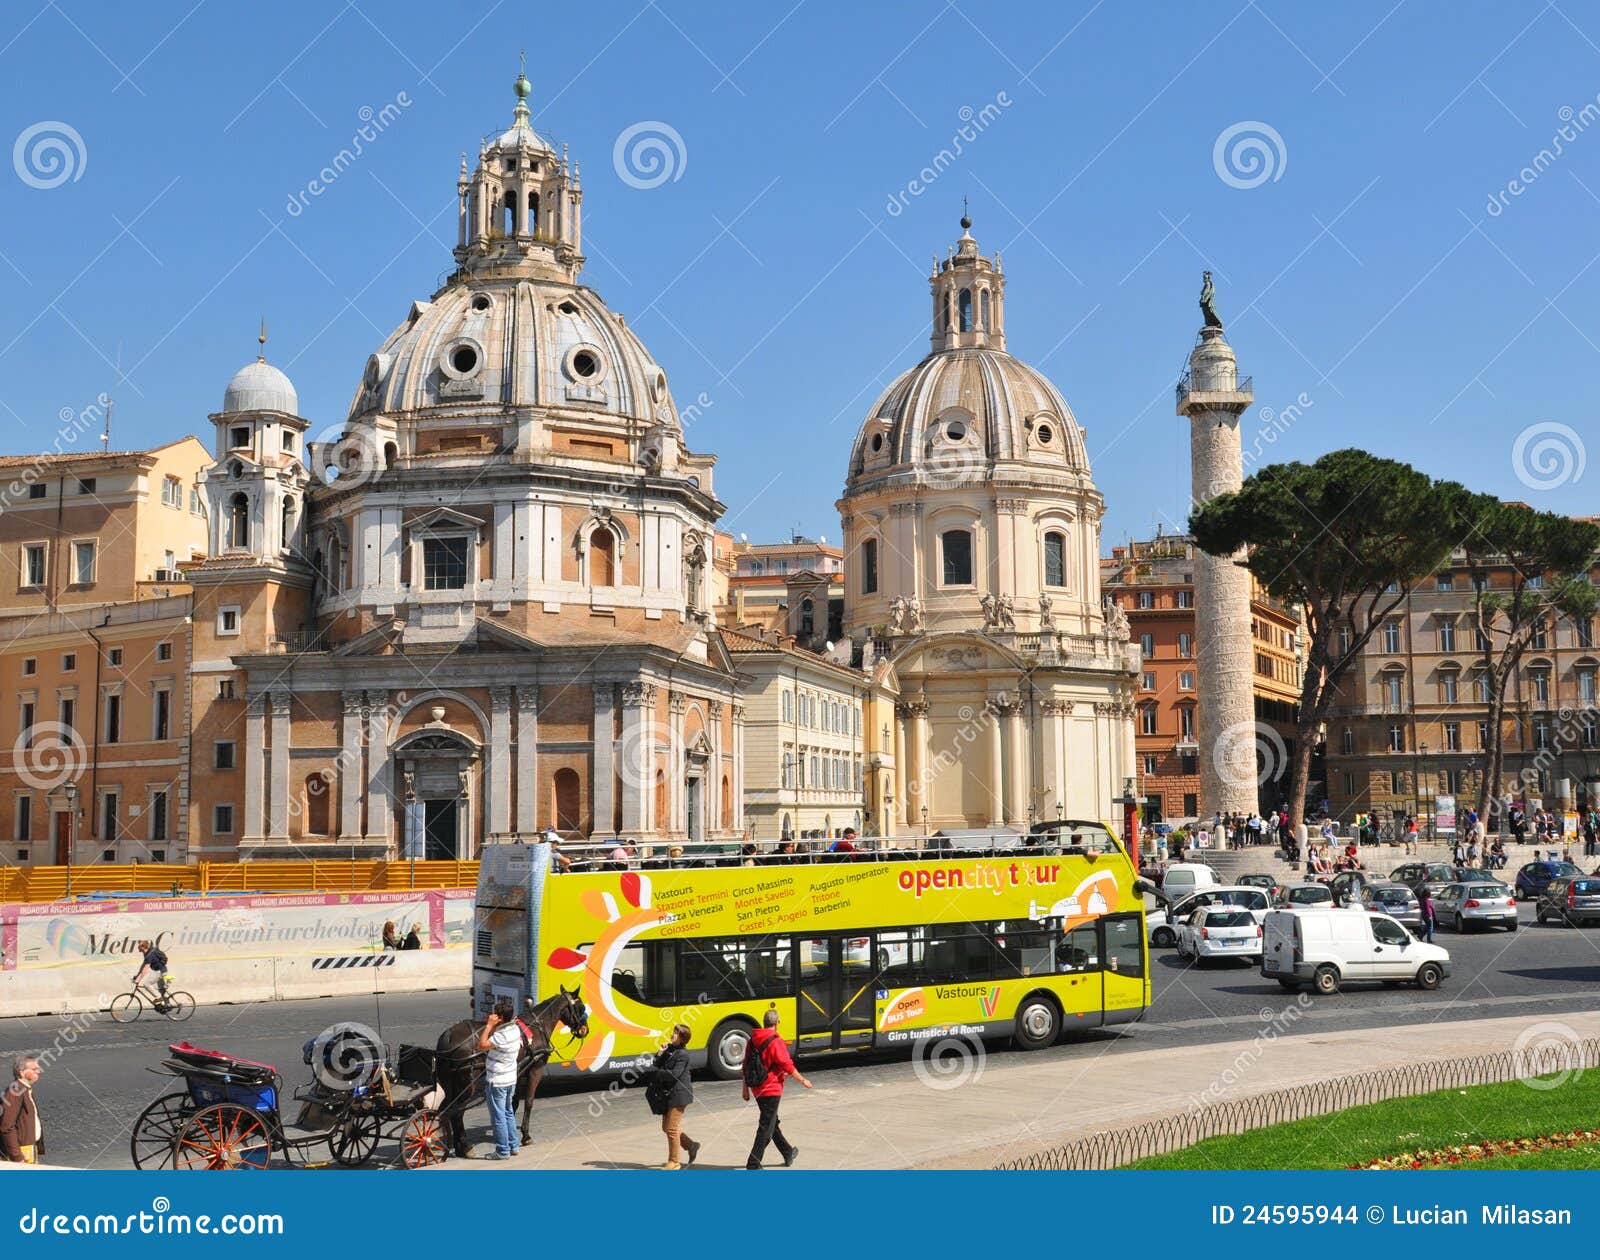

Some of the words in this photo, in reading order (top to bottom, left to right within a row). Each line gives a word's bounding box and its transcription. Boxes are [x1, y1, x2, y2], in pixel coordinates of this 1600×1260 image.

[654, 885, 694, 900] Vastours
[732, 886, 755, 898] Circo
[756, 877, 794, 892] Massimo
[809, 877, 845, 893] Augusto
[656, 898, 695, 913] Stazione
[696, 889, 729, 904] Termini
[735, 896, 763, 909] Monte
[765, 888, 795, 902] Savello
[811, 890, 841, 904] Tritone
[658, 911, 687, 924] Piazza
[688, 903, 724, 917] Venezia
[737, 911, 753, 922] San
[755, 904, 780, 917] Pietro
[813, 898, 851, 916] Barberini
[659, 921, 701, 937] Colosseo
[739, 919, 765, 933] Castel
[777, 909, 808, 923] Angelo
[935, 986, 987, 1000] Vastours
[897, 998, 920, 1010] Open
[887, 1030, 908, 1042] Giro
[909, 1025, 947, 1039] turistico
[949, 1025, 958, 1037] di
[960, 1024, 985, 1035] Roma
[609, 1059, 635, 1069] Rome
